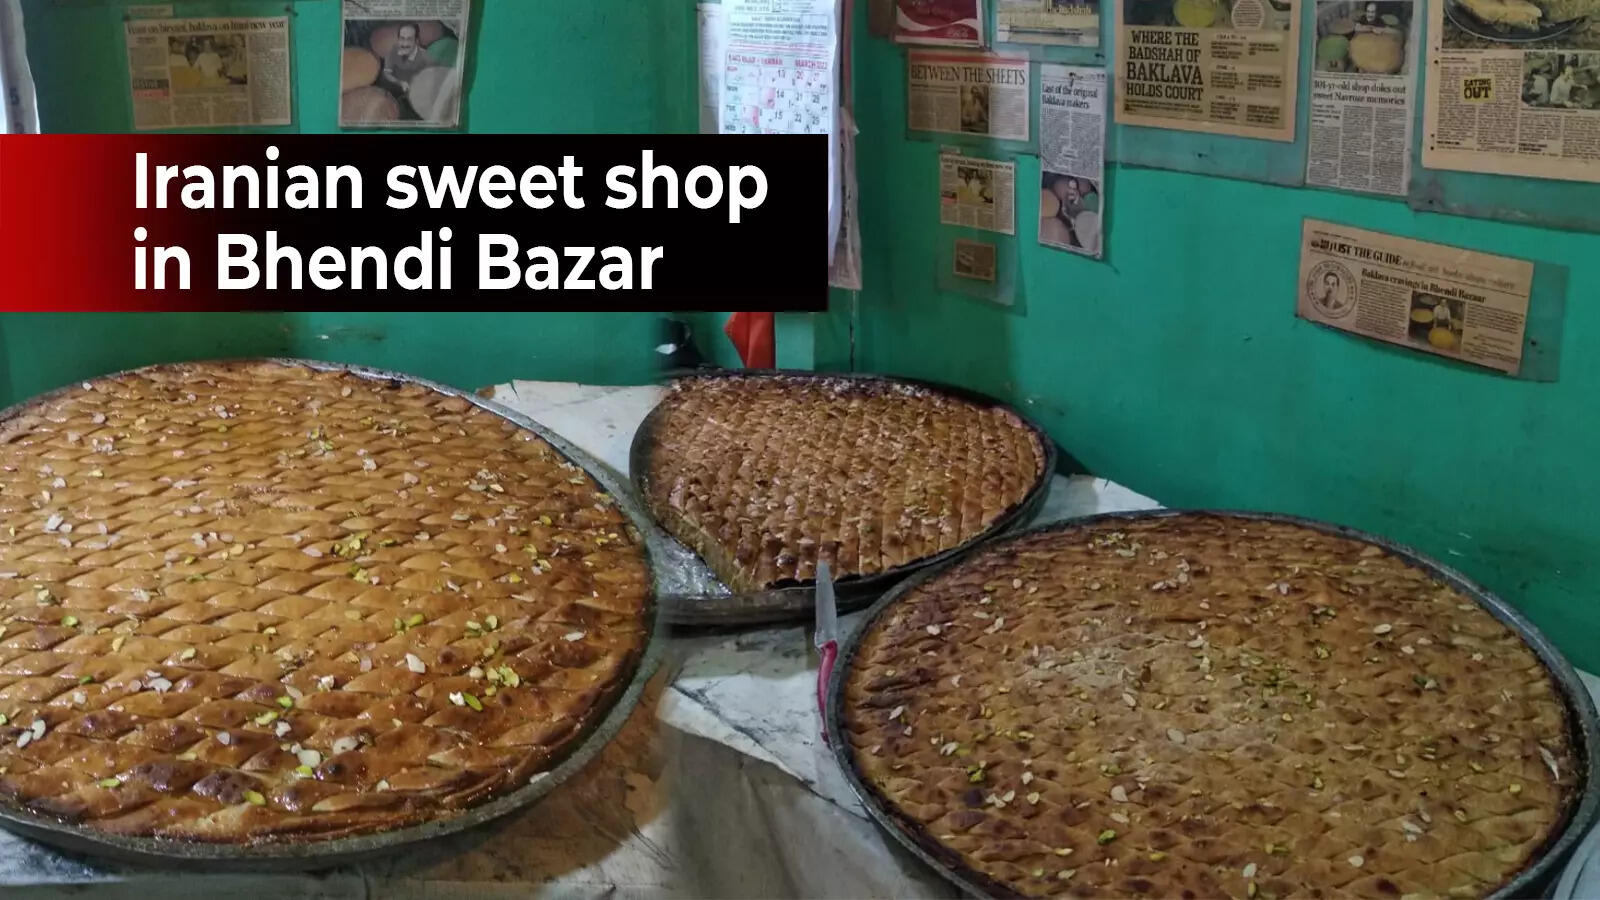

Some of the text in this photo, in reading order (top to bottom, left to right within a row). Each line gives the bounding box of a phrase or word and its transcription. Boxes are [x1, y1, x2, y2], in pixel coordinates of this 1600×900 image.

[1132, 30, 1200, 46] WHERE THE
[1128, 46, 1201, 63] BADSHAH OF
[910, 64, 1026, 86] BETWEEN THE SHEETS
[1126, 61, 1204, 86] BAKLAVA
[1392, 84, 1406, 94] out
[1464, 78, 1491, 88] EATING
[1073, 87, 1098, 100] original
[1126, 83, 1204, 101] HOLDS COURT
[1367, 95, 1405, 105] memories
[1464, 87, 1491, 99] OUT
[1354, 246, 1372, 260] THE
[1373, 250, 1402, 265] GUIDE
[1361, 267, 1389, 282] Baklava
[1390, 275, 1420, 289] cravings
[1421, 280, 1429, 288] in
[1430, 282, 1458, 297] Bhendi
[1459, 288, 1487, 303] Bazaar
